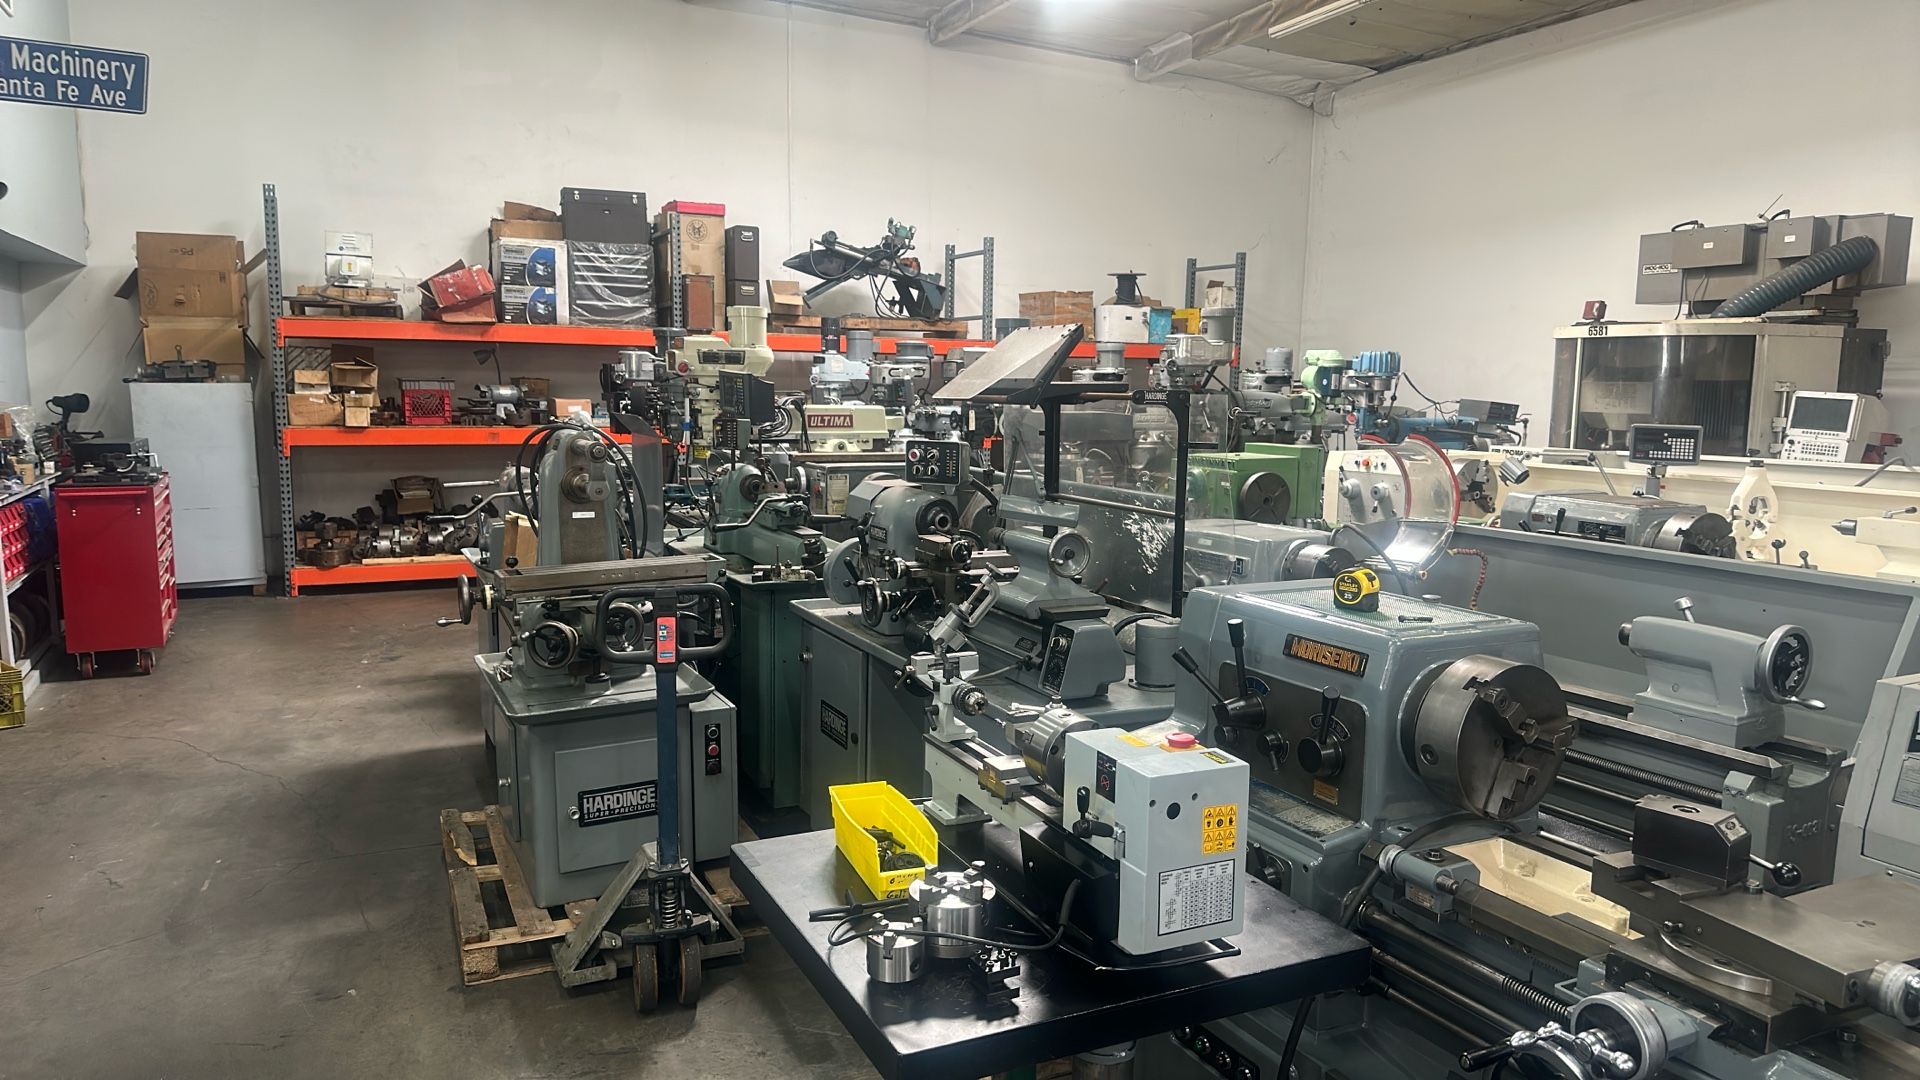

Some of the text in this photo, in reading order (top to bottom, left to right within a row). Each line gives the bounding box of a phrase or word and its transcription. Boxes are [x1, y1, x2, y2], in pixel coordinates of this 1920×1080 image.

[11, 43, 136, 90] Machinery
[56, 80, 80, 102] Fe
[90, 84, 127, 107] Ave
[1588, 325, 1608, 337] 6581
[1144, 391, 1169, 400] HARDINGE
[810, 415, 852, 427] ULTIMA
[583, 787, 656, 814] HARDINGE
